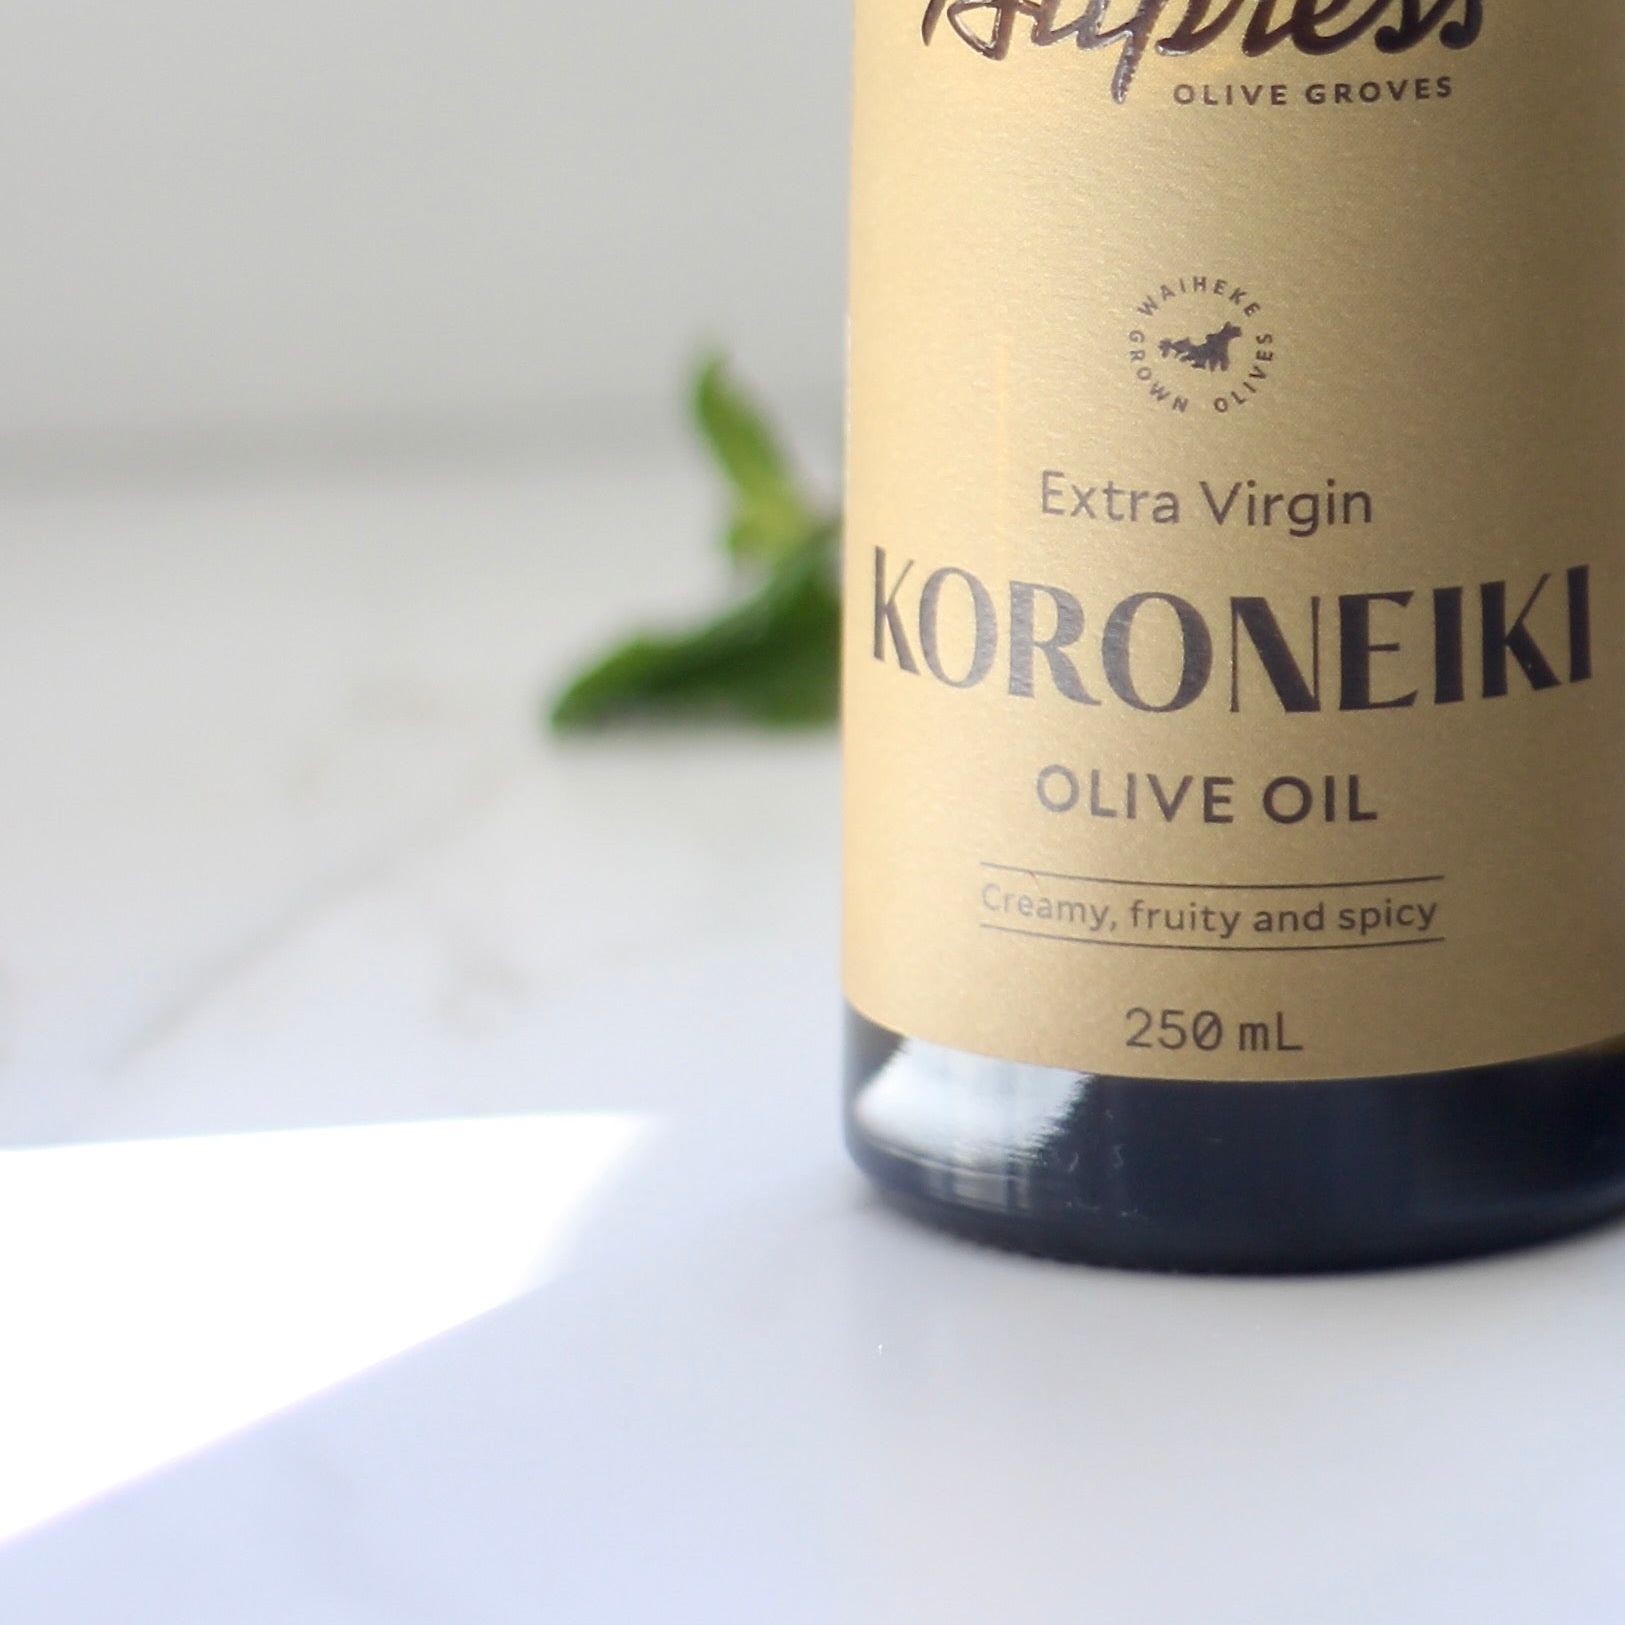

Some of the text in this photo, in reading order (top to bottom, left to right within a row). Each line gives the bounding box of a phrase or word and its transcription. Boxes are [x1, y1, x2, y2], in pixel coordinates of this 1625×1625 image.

[1173, 75, 1453, 106] OLIVE GROVES
[1129, 275, 1274, 413] WAIHEKE GROWN OLIVES
[1039, 470, 1373, 538] Extra Virgin
[872, 544, 1592, 714] KORONEIKI
[1035, 764, 1378, 825] OLIVE OIL
[980, 883, 1438, 940] Creamy, fruity and spicy
[1124, 1007, 1304, 1052] 250 mL
